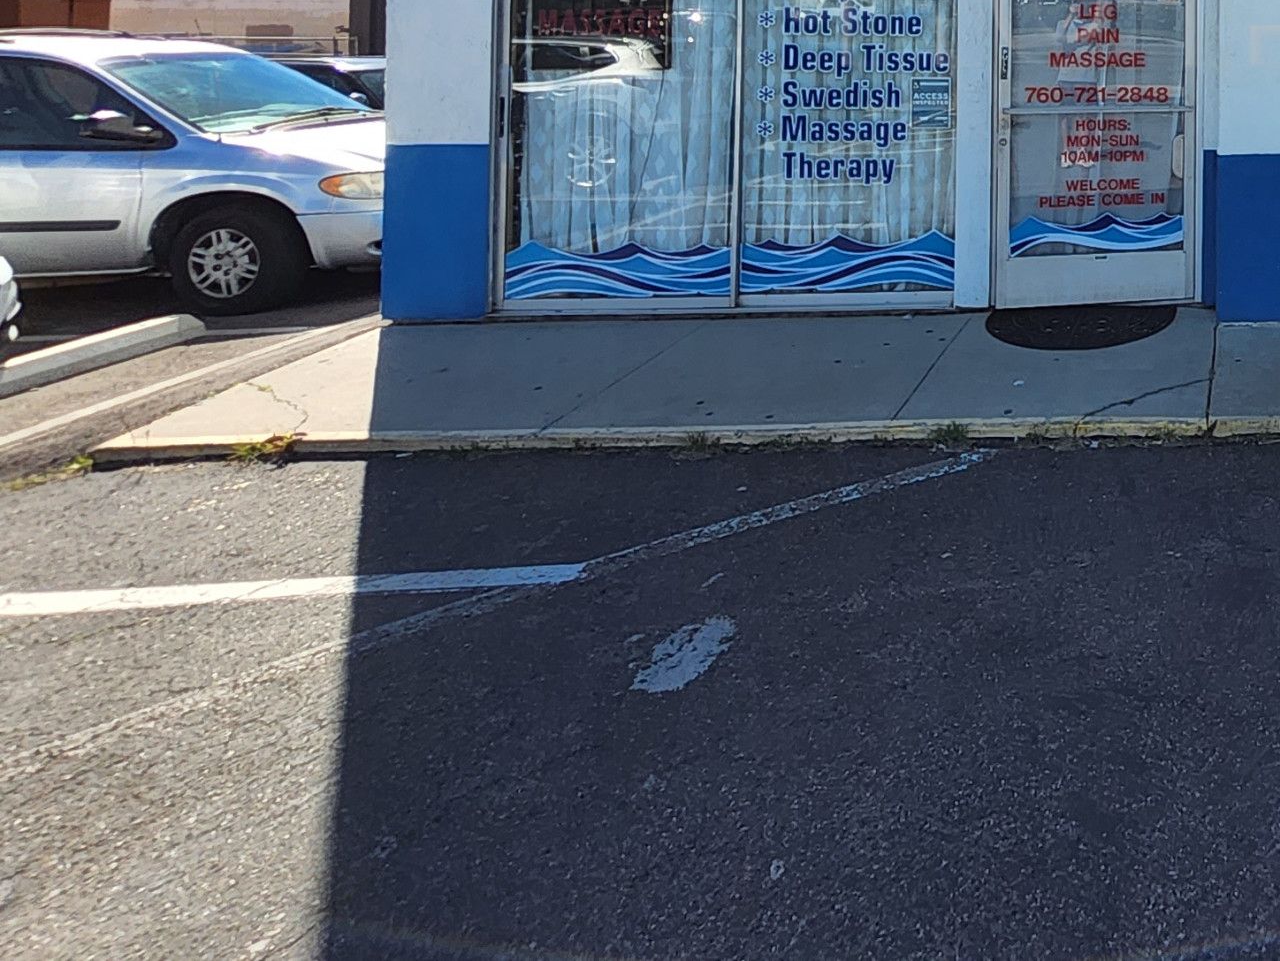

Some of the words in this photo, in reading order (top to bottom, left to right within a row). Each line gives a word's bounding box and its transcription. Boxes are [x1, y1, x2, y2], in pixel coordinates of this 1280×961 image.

[1079, 3, 1119, 20] LEG
[537, 7, 665, 36] MASSAGE
[783, 7, 832, 34] Hot
[842, 7, 923, 35] Stone
[1077, 27, 1120, 44] PAIN
[783, 44, 851, 78] Deep
[861, 44, 950, 72] Tissue
[1049, 51, 1147, 68] MASSAGE
[782, 81, 901, 109] Swedish
[913, 92, 949, 100] ACCESS
[1024, 87, 1169, 104] 760-721-2848
[781, 114, 908, 148] Massage
[1075, 119, 1131, 132] HOURS:
[1066, 134, 1140, 147] MON-SUN
[1061, 150, 1145, 163] 10AM-10PM
[782, 152, 896, 185] Therapy
[1065, 178, 1141, 192] WELCOME
[1039, 195, 1096, 208] PLEASE
[1101, 194, 1145, 207] COME
[1151, 193, 1166, 205] IN
